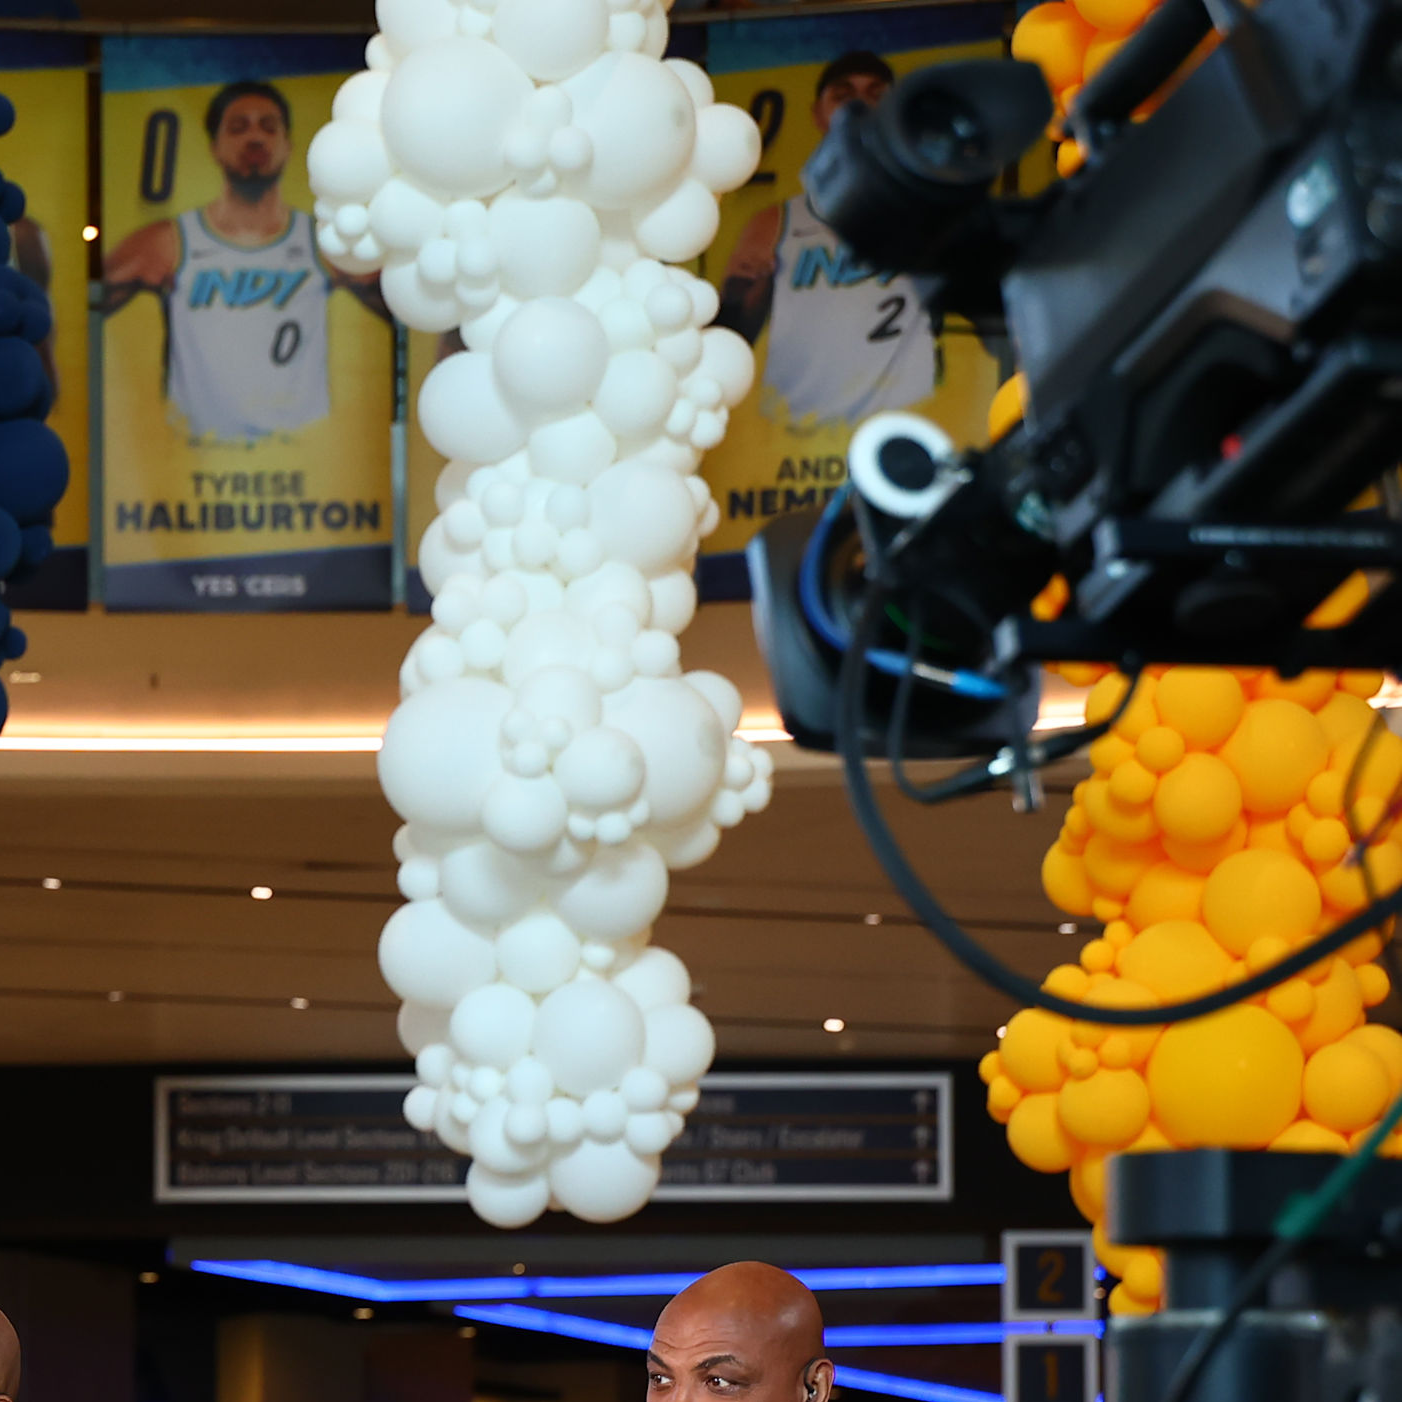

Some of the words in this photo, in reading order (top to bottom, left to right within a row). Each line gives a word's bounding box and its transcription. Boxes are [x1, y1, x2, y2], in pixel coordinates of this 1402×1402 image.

[140, 109, 179, 204] 0
[188, 268, 311, 310] INDY
[791, 246, 894, 290] IND
[866, 294, 905, 343] 2
[269, 319, 302, 367] 0
[191, 471, 306, 498] TYRESE
[776, 456, 851, 482] AND
[115, 501, 383, 533] HALIBURTON
[728, 487, 838, 520] NEM
[192, 575, 238, 597] YES
[1037, 1250, 1066, 1303] 2
[1043, 1352, 1059, 1400] 1
